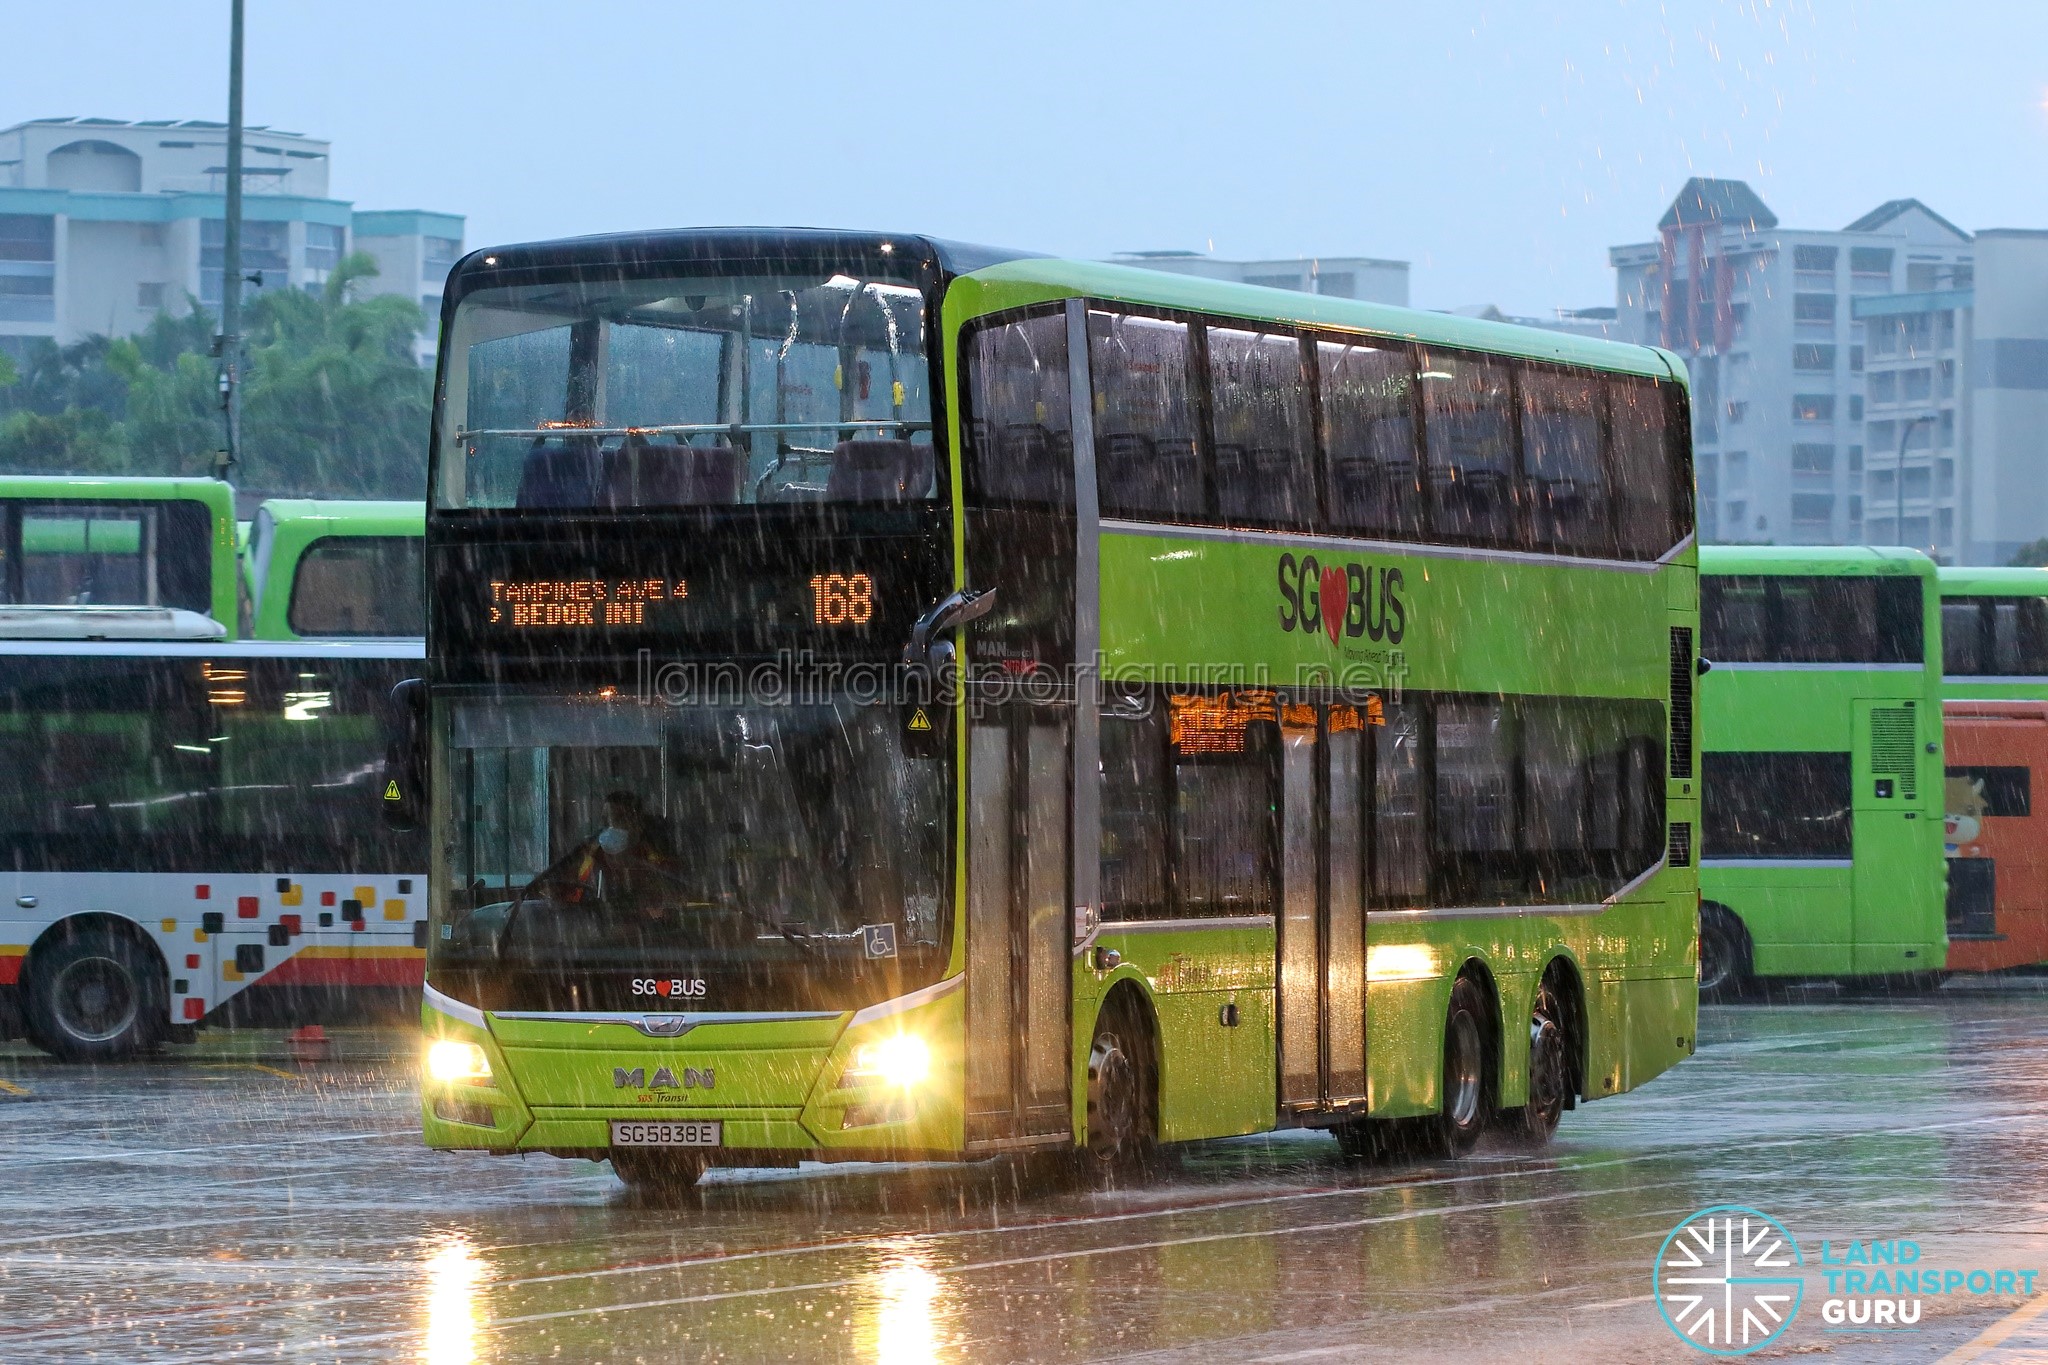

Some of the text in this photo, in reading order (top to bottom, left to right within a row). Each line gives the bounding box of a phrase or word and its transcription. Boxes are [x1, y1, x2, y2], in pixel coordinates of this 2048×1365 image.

[489, 579, 689, 602] TAMPINES AVE 4
[810, 572, 873, 625] 168
[512, 601, 645, 626] BEDOK INT
[976, 639, 1008, 657] MAN
[614, 1067, 715, 1089] MAN
[654, 1091, 689, 1103] Transit
[619, 1125, 713, 1143] SG5838E
